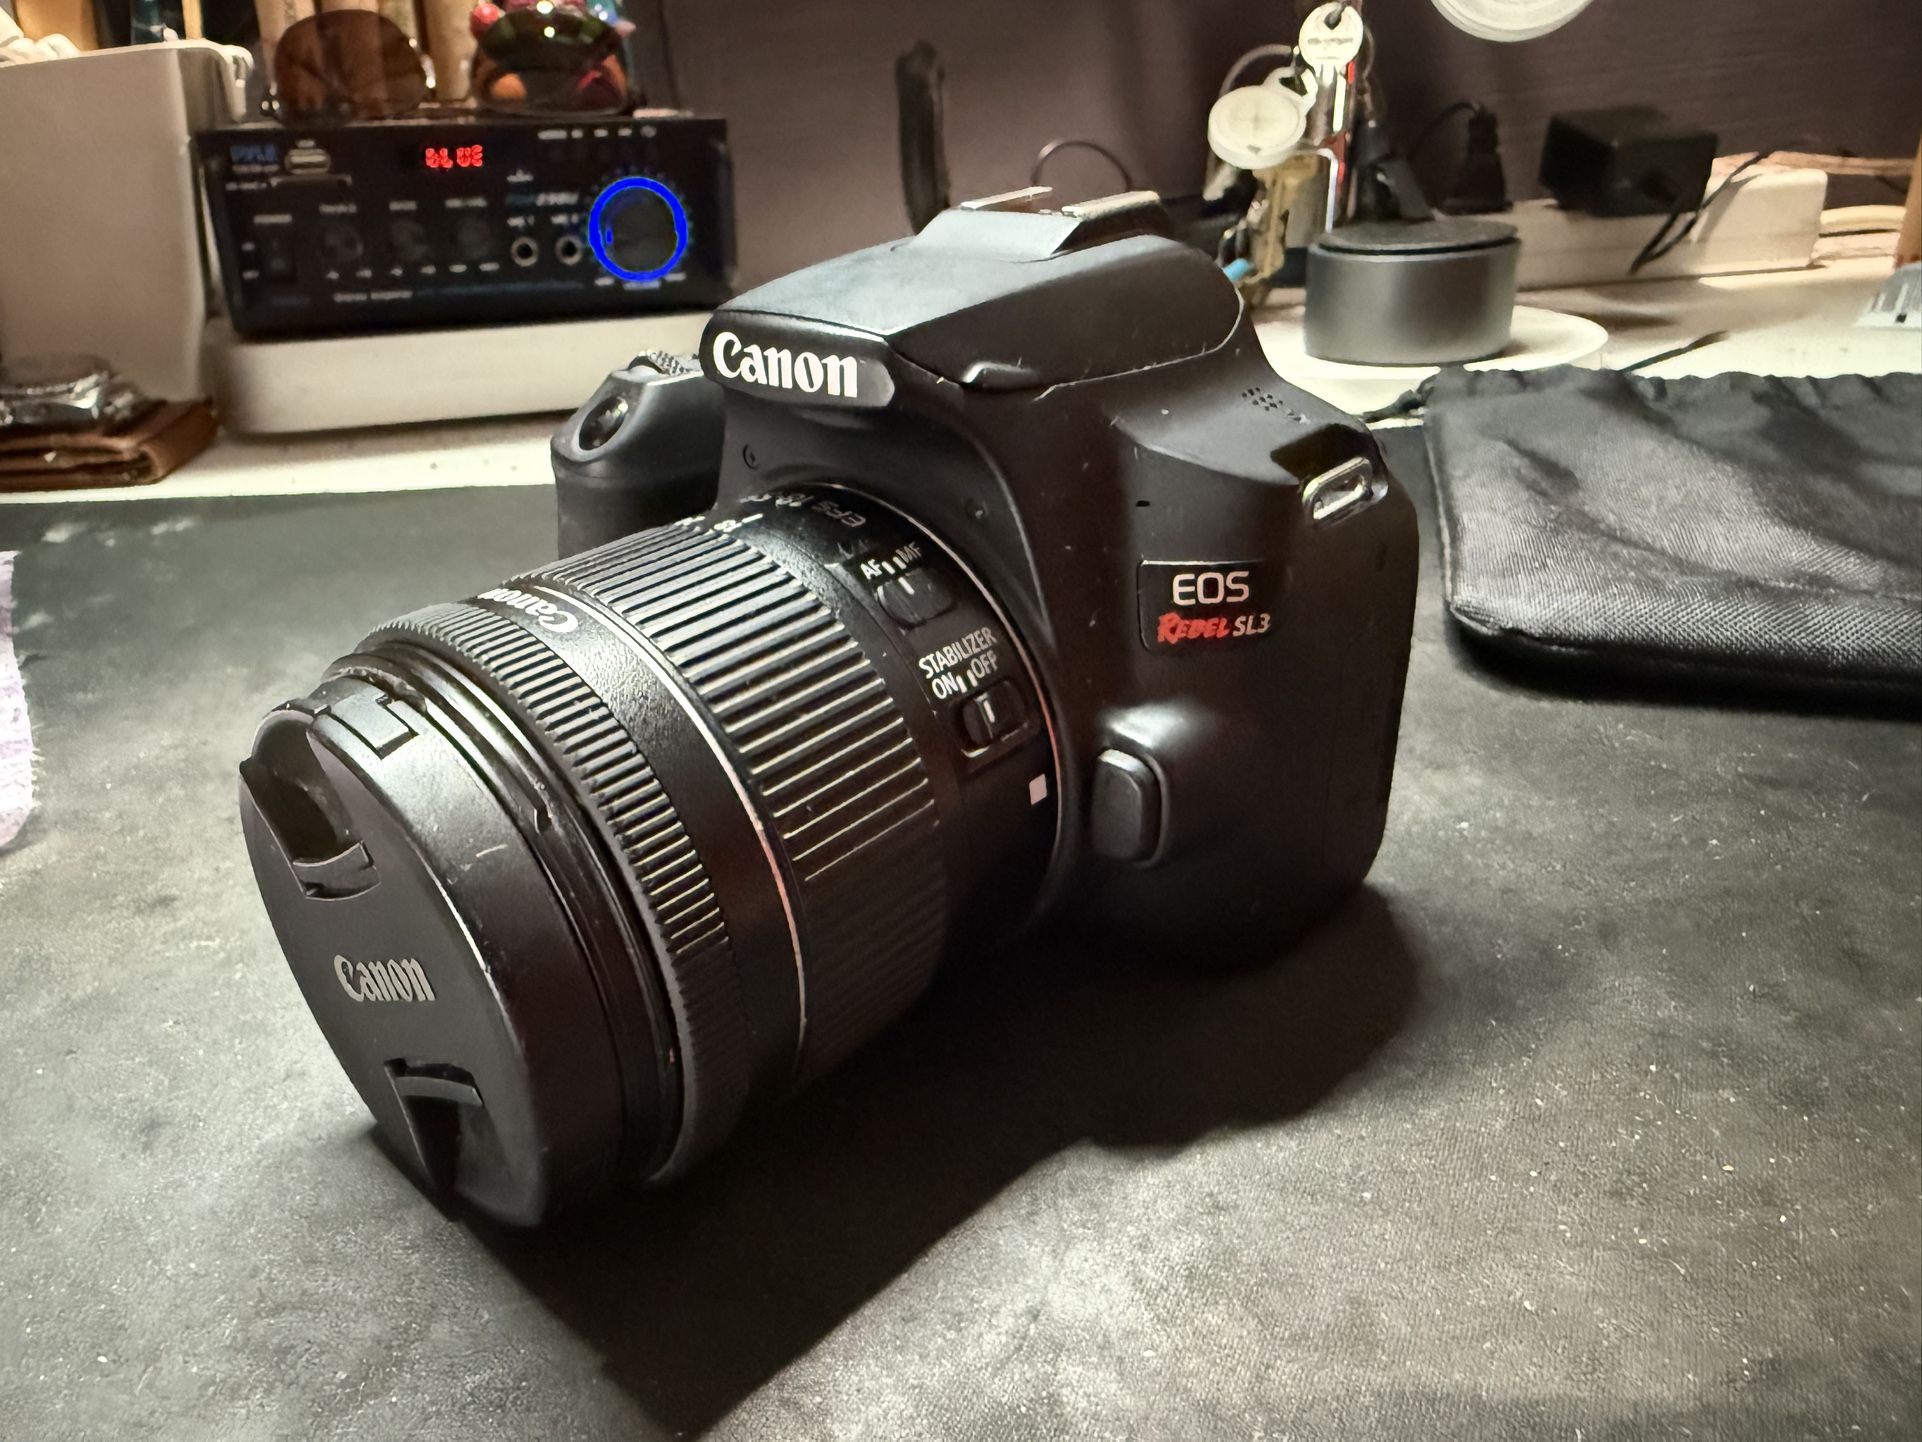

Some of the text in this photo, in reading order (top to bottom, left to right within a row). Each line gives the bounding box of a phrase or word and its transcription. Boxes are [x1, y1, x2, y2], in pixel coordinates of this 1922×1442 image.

[712, 331, 858, 398] Canon
[860, 541, 922, 580] AF MF
[477, 588, 579, 633] Canon
[1172, 570, 1250, 606] EOS
[1232, 612, 1272, 637] SL3
[918, 626, 998, 680] STABILIZER
[931, 649, 998, 700] ON OFF
[333, 954, 436, 1002] Canon
